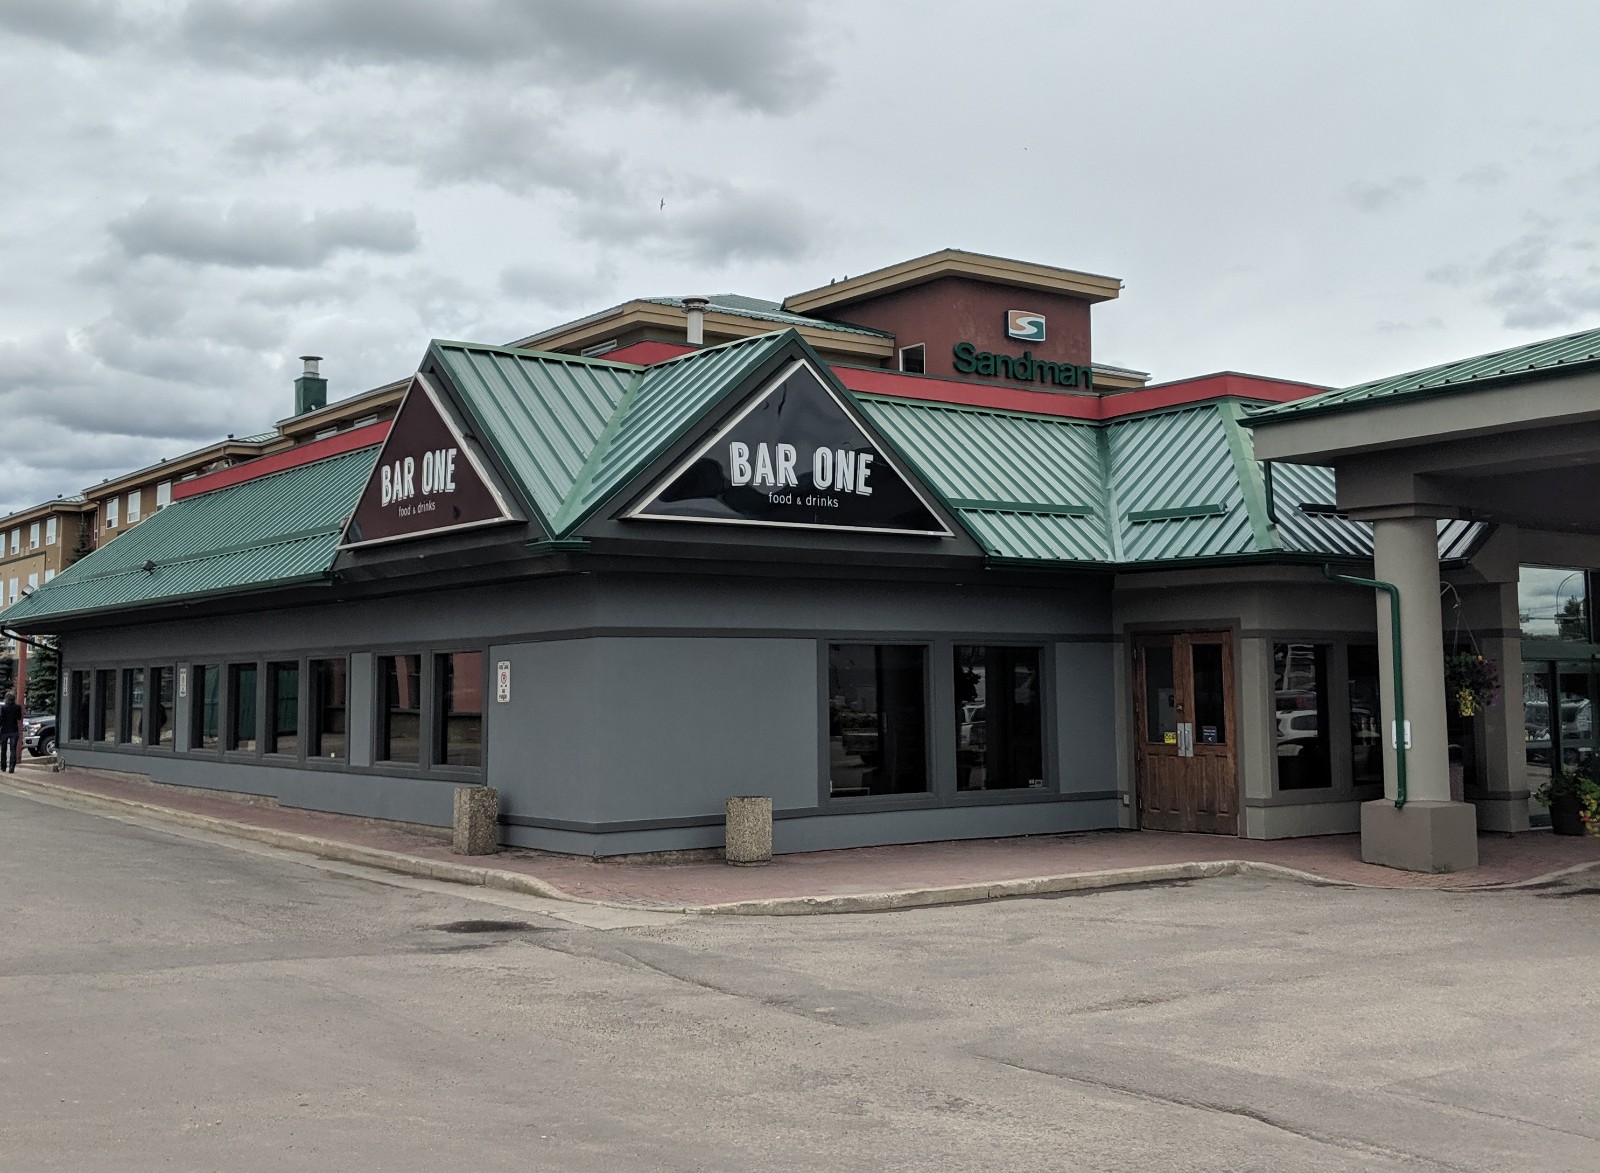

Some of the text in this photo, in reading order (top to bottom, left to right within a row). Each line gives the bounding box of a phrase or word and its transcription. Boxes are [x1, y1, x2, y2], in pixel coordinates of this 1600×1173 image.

[953, 342, 1093, 389] Sandman
[381, 448, 457, 507] BAR ONE
[730, 441, 874, 496] BAR ONE
[398, 504, 411, 517] food
[417, 500, 436, 514] drinks
[768, 492, 839, 508] food & drinks
